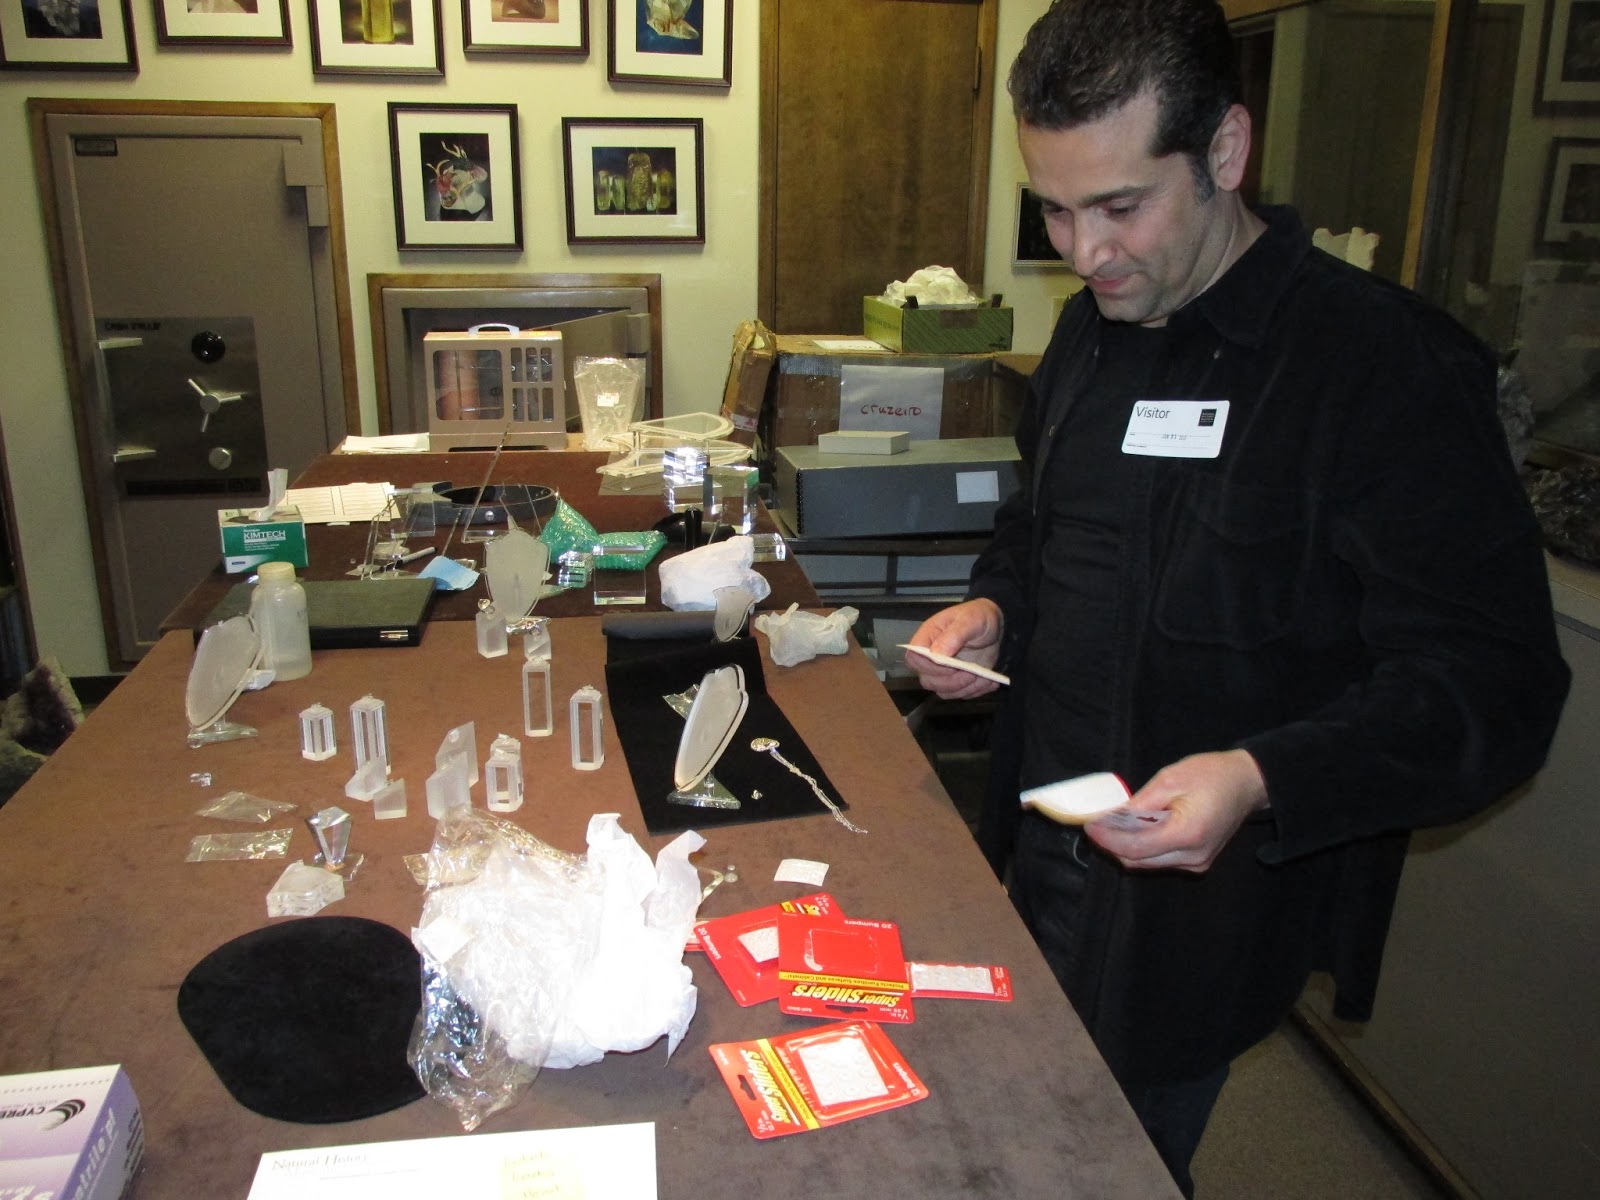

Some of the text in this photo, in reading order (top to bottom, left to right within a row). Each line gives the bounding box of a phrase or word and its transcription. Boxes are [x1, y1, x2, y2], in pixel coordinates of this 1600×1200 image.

[1136, 406, 1170, 419] Visitor
[244, 530, 286, 540] KIMTECH
[844, 919, 880, 928] Bumpers
[702, 933, 722, 960] Bumpers
[892, 1061, 916, 1089] Bumpers
[272, 1153, 369, 1170] Natural History
